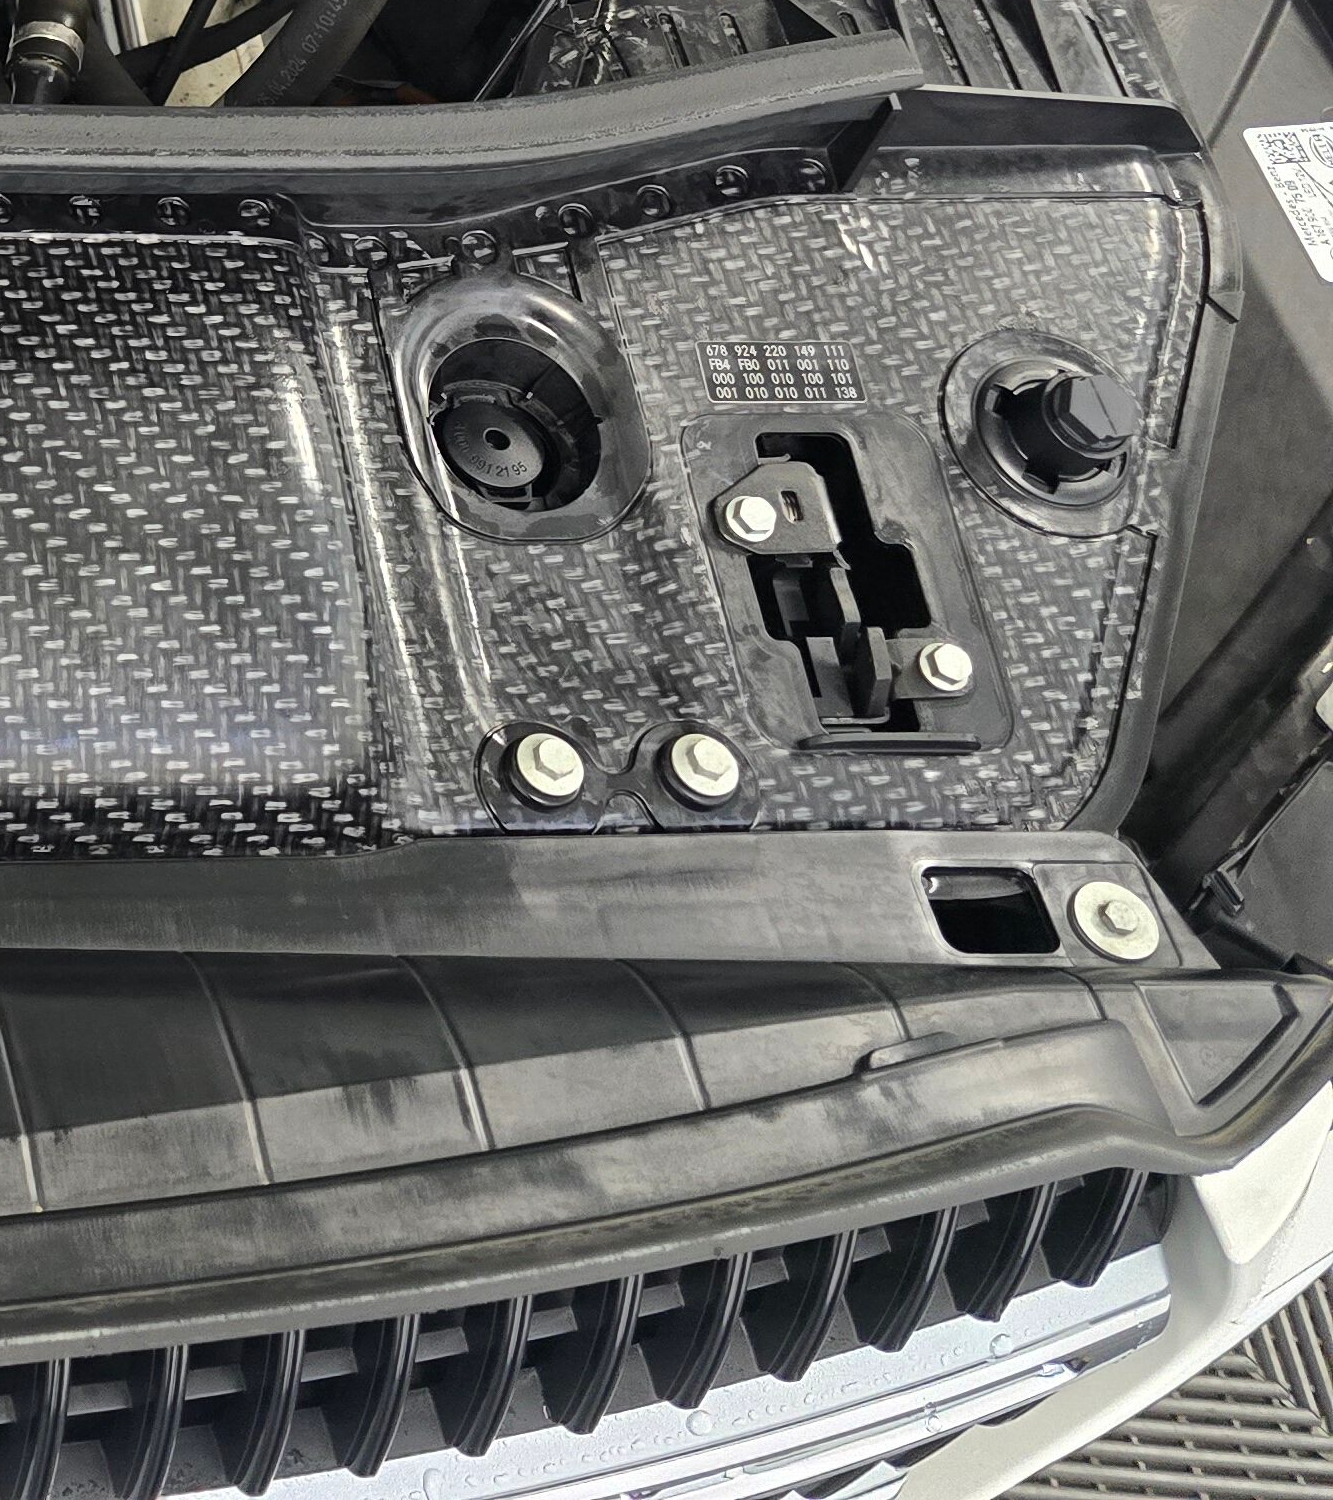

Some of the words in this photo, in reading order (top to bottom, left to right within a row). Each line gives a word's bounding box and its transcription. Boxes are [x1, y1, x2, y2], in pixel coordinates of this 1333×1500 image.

[1267, 166, 1286, 189] Benz
[1291, 193, 1305, 204] 75
[1285, 199, 1318, 246] Mercedes
[706, 345, 728, 357] 678
[734, 345, 757, 357] 924
[763, 345, 786, 357] 220
[794, 345, 815, 357] 149
[824, 345, 844, 357] 111
[708, 358, 731, 370] FB4
[767, 358, 790, 370] 011
[796, 358, 818, 370] 001
[827, 358, 849, 370] 110
[712, 373, 735, 385] 000
[743, 373, 765, 385] 100
[771, 373, 794, 385] 010
[802, 373, 824, 385] 100
[831, 373, 852, 385] 101
[716, 387, 738, 399] 001
[745, 387, 769, 399] 010
[775, 387, 798, 399] 010
[804, 387, 827, 399] 011
[835, 387, 857, 399] 138
[495, 465, 510, 477] 21
[511, 461, 528, 476] 95
